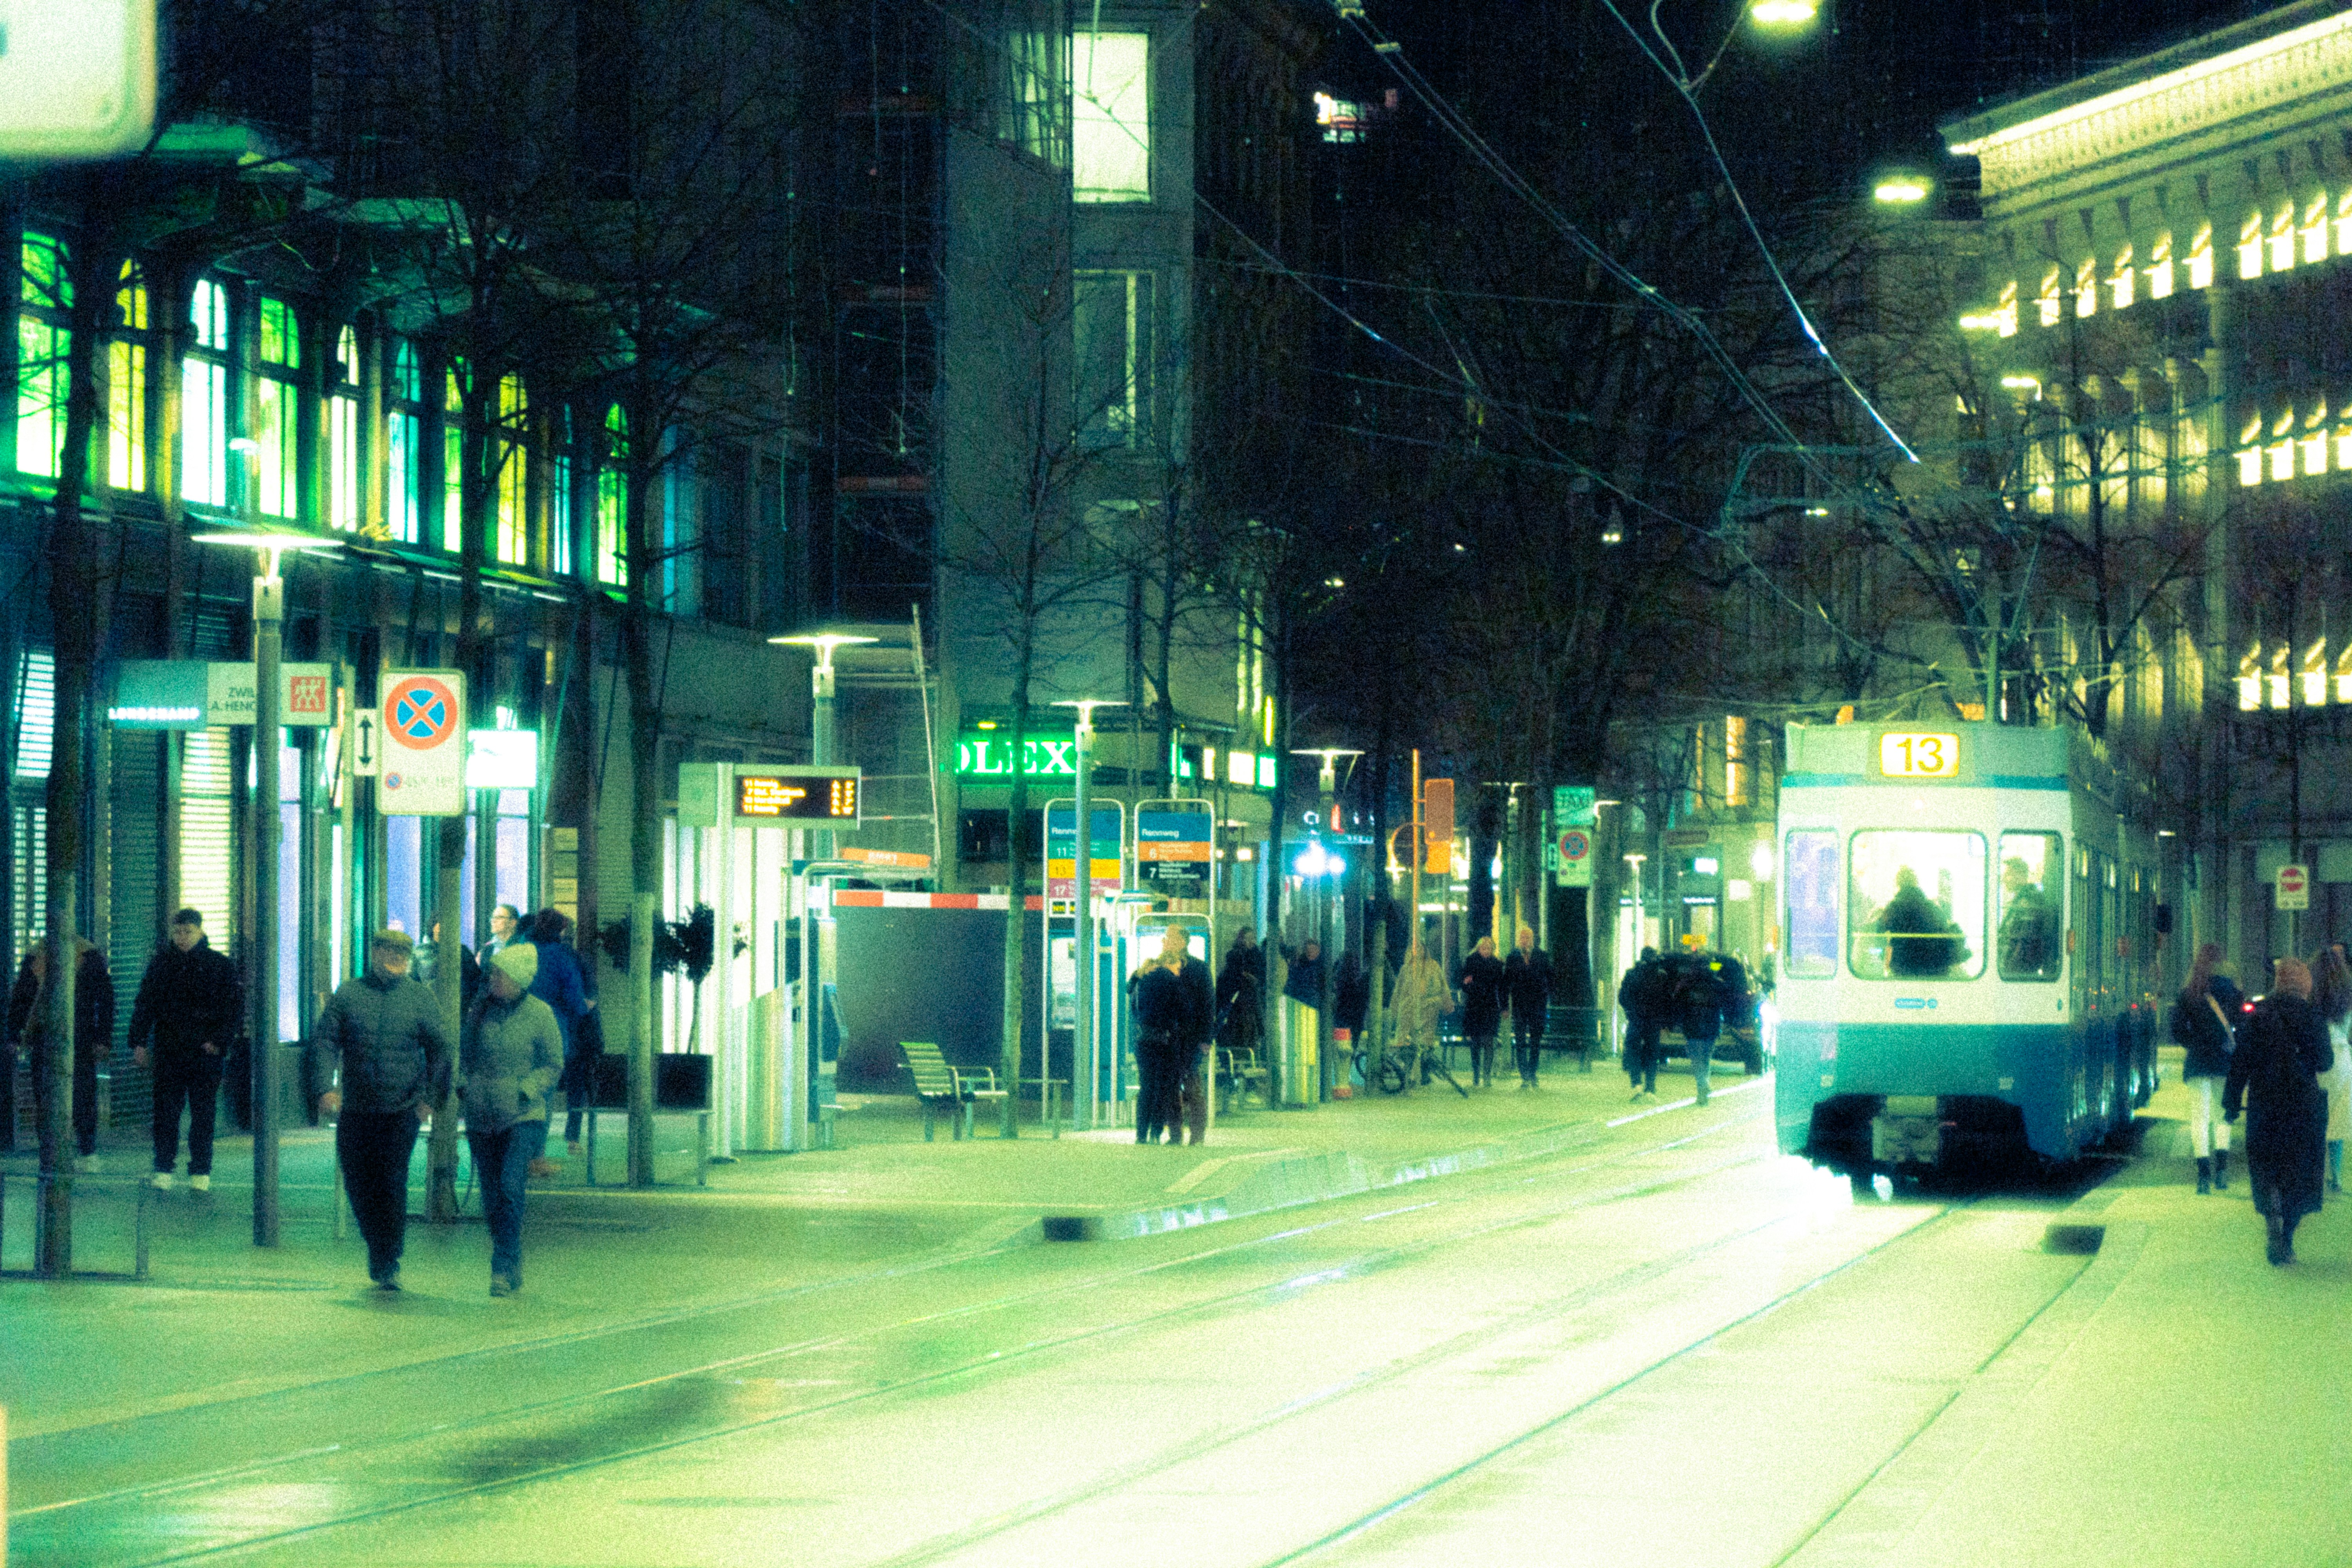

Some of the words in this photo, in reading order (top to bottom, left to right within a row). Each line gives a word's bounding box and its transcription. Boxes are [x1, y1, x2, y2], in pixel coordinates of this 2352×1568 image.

[1897, 737, 1944, 772] 13
[1142, 828, 1179, 839] Rennweg
[1057, 847, 1066, 857] 11
[1149, 848, 1156, 859] 6
[1149, 867, 1156, 878] 7
[1054, 885, 1066, 896] 17
